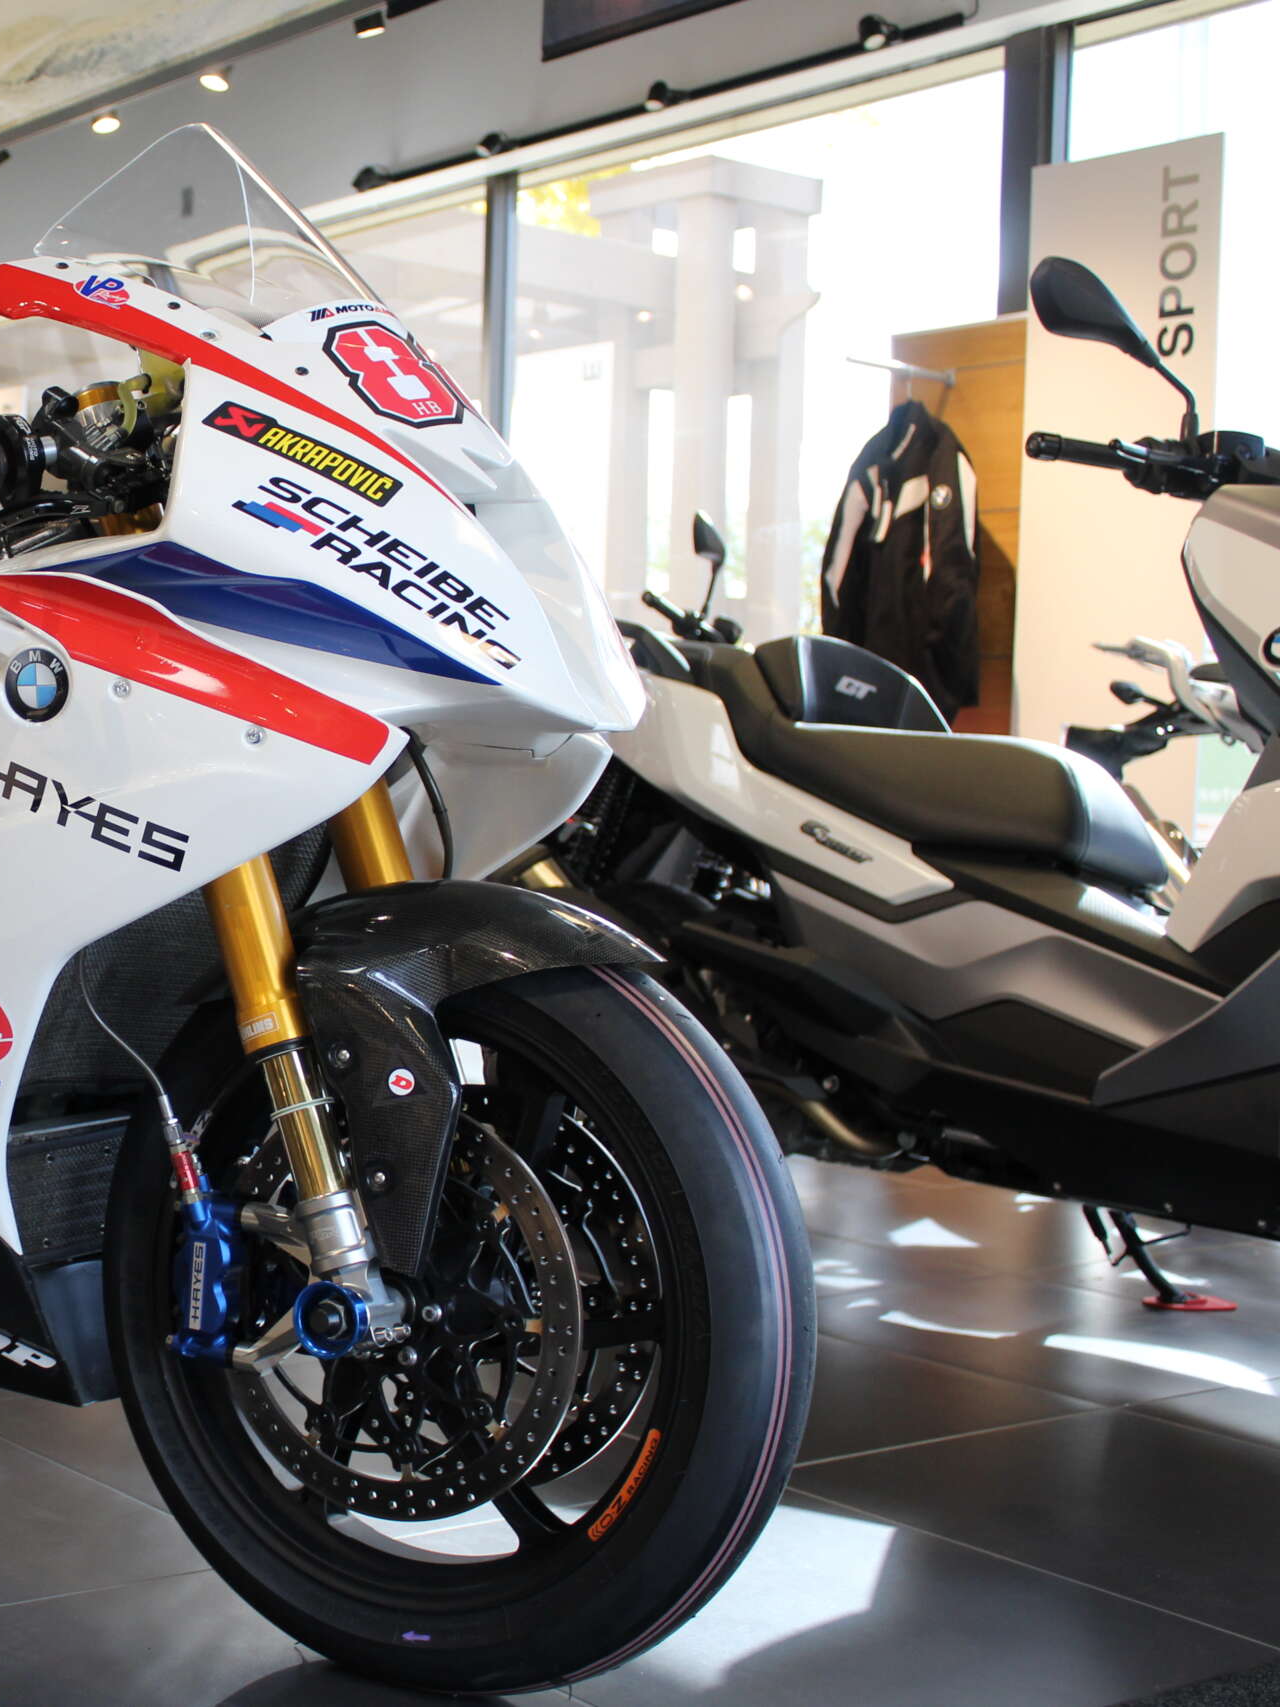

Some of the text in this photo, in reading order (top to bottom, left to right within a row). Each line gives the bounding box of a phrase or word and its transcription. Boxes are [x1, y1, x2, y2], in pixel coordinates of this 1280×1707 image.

[1157, 165, 1200, 357] SPORT
[411, 401, 442, 416] HB
[257, 476, 511, 631] SCHEIBE
[310, 532, 522, 670] RACING
[10, 650, 63, 674] BMW
[835, 675, 878, 700] GT
[191, 1244, 205, 1322] HAYES
